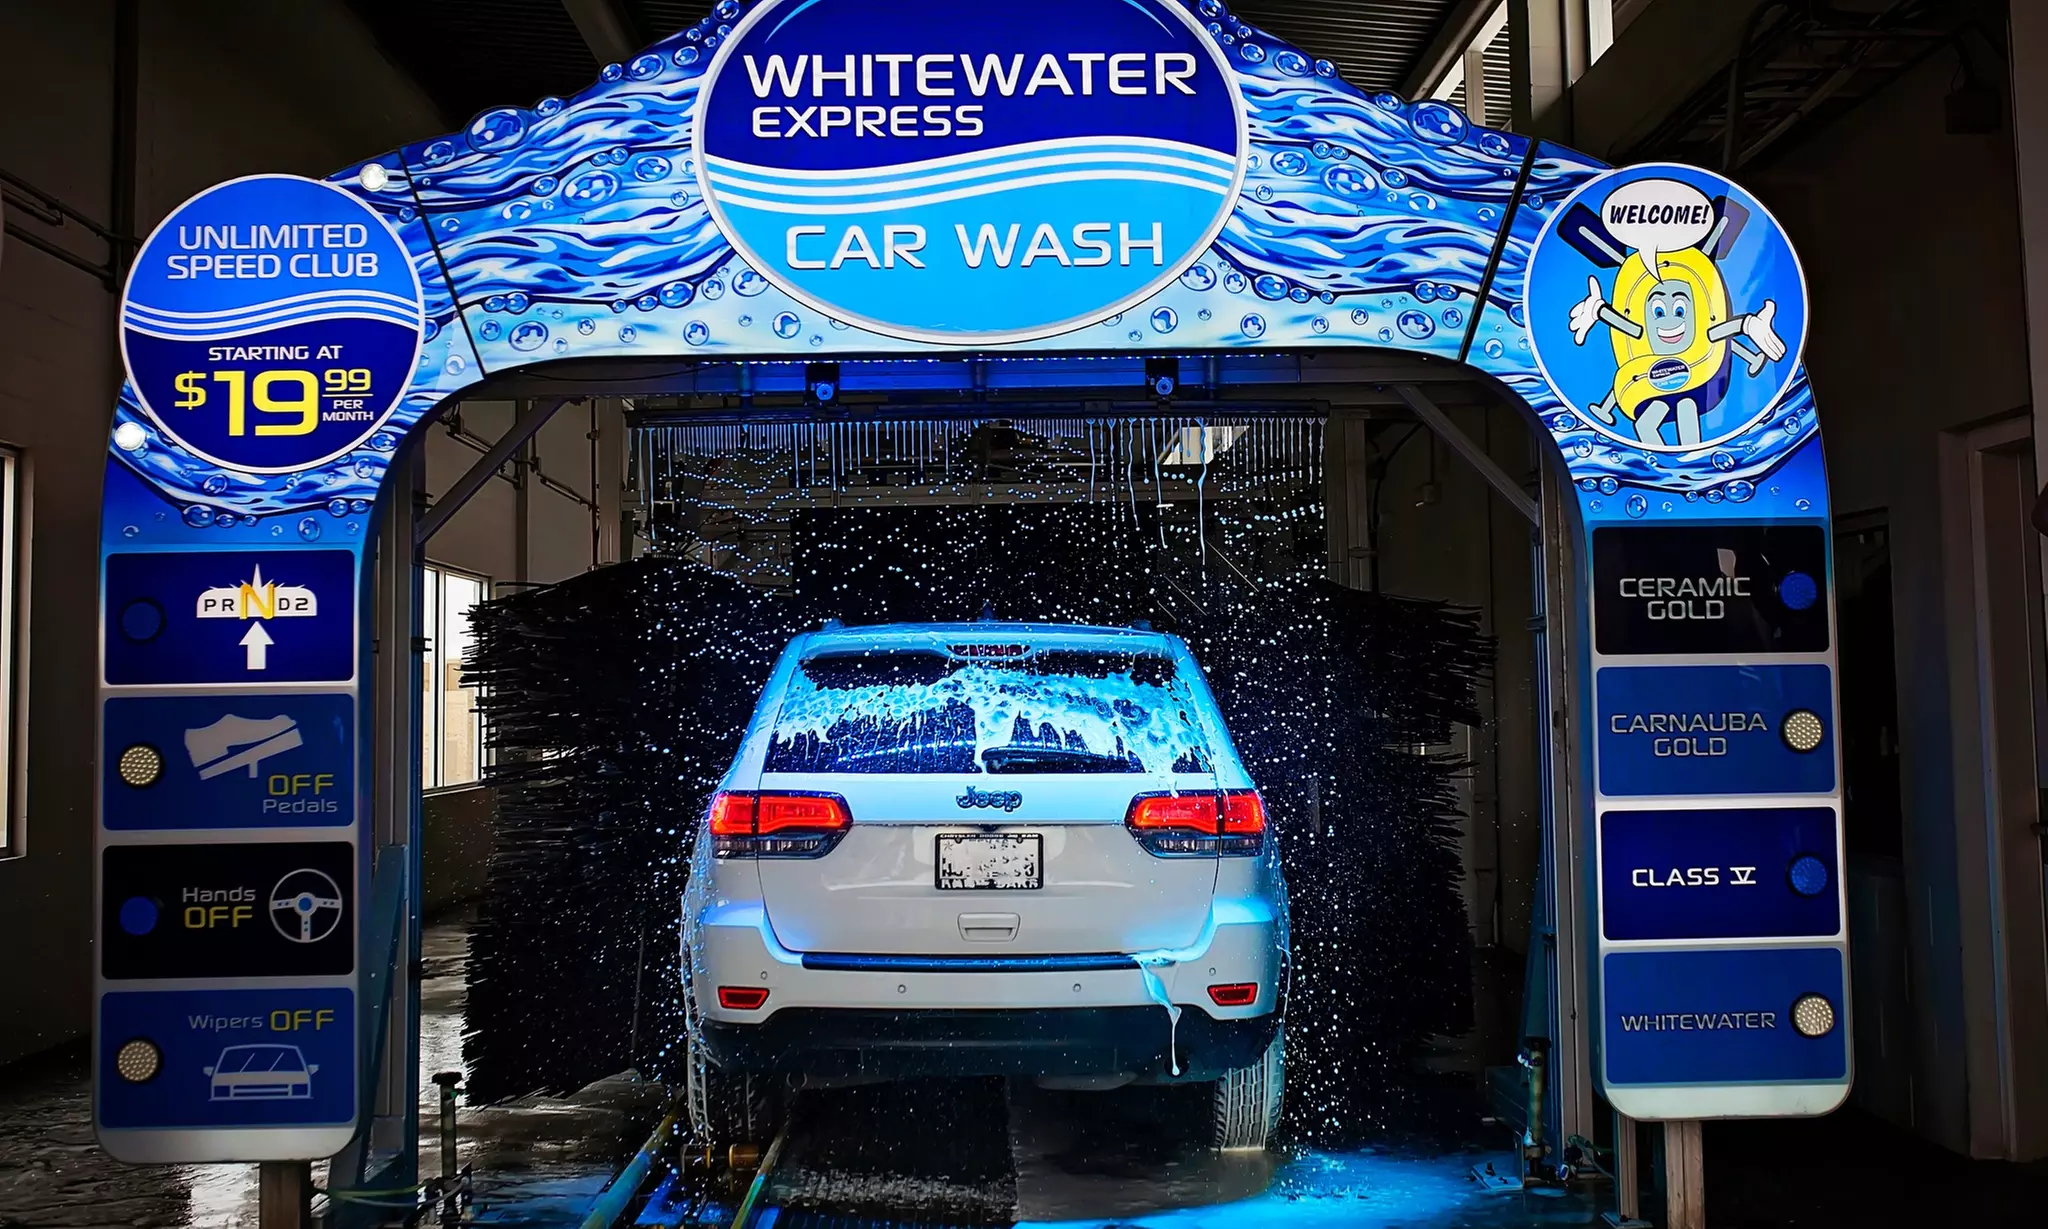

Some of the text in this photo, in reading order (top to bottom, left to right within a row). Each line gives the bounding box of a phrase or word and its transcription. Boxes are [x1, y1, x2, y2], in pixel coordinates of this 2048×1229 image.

[743, 53, 1197, 98] WHITEWATER
[751, 105, 983, 139] EXPRESS
[1609, 204, 1710, 225] WELCOME!
[179, 223, 367, 250] UNLIMITED
[786, 222, 1164, 269] CAR WASH
[167, 253, 379, 280] SPEED CLUB
[208, 345, 343, 361] STARTING AT
[333, 399, 363, 409] PER
[322, 411, 374, 421] MONTH
[1619, 577, 1751, 597] CERAMIC
[1647, 600, 1725, 620] GOLD
[1610, 713, 1768, 733] CARNAUBA
[1653, 737, 1727, 756] GOLD
[268, 774, 334, 796] OFF
[263, 798, 338, 814] Pedals
[956, 785, 1023, 812] Jeep
[1631, 868, 1719, 887] CLASS
[182, 887, 256, 902] Hands
[184, 906, 253, 928] OFF
[188, 1009, 334, 1033] Wipers OFF
[1621, 1012, 1776, 1032] WHITEWATER
